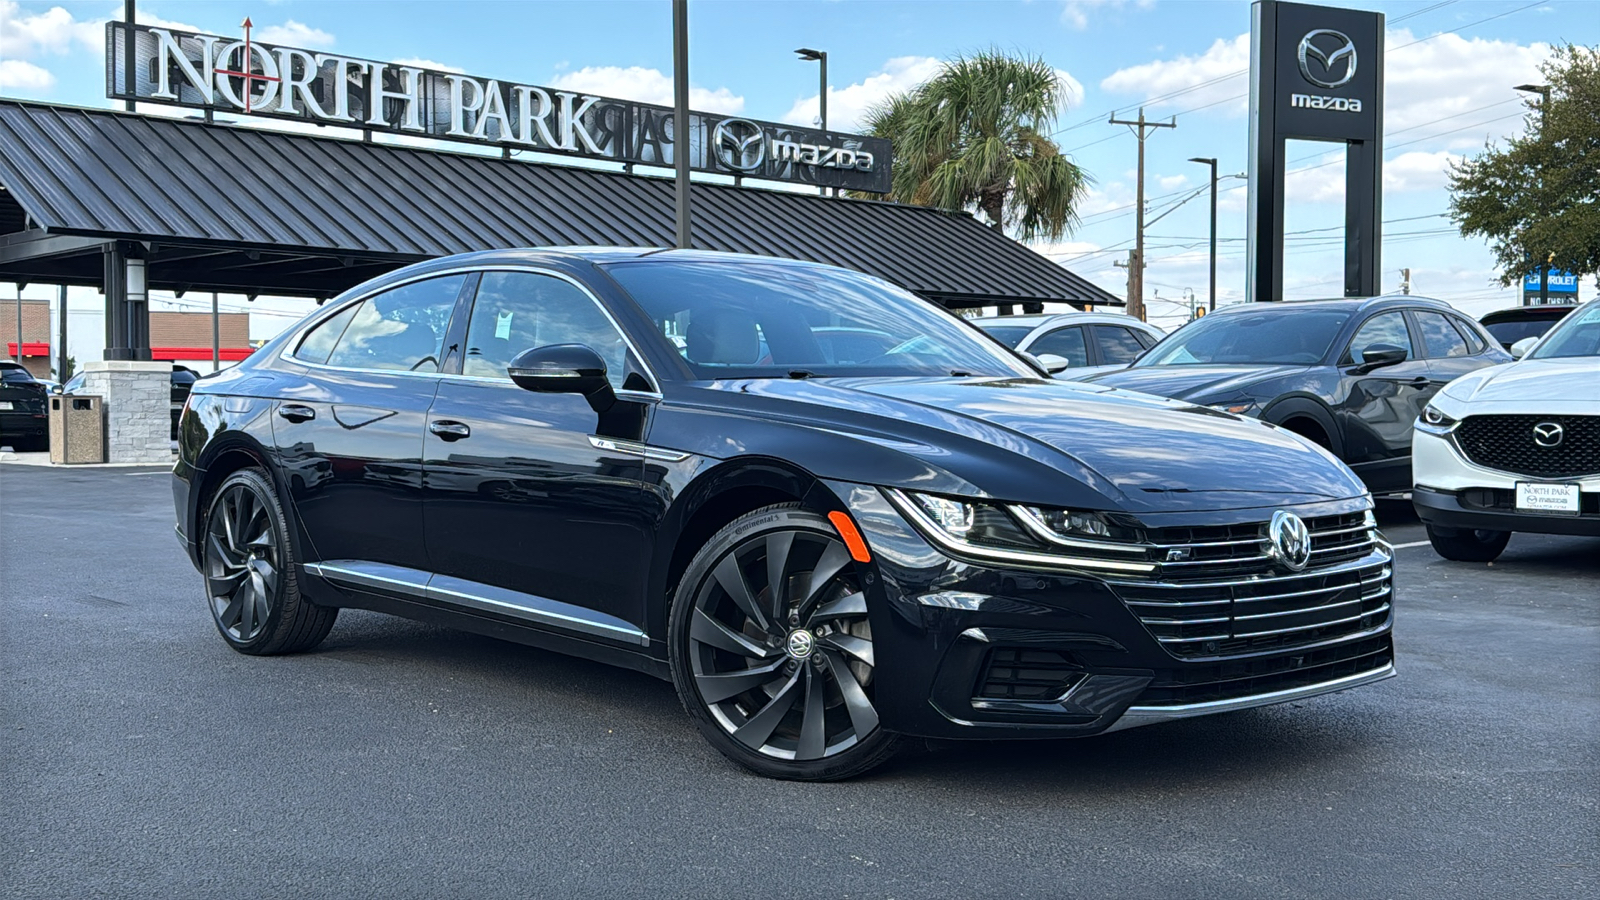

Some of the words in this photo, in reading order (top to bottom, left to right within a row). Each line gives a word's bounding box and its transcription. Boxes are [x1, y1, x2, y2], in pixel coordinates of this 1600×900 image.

[148, 28, 427, 132] NORTH
[444, 74, 604, 154] PARK
[1291, 93, 1362, 112] mazda
[770, 138, 875, 173] mazda
[1524, 487, 1549, 495] NORTH
[1551, 488, 1570, 496] PARK
[735, 515, 773, 535] Continental
